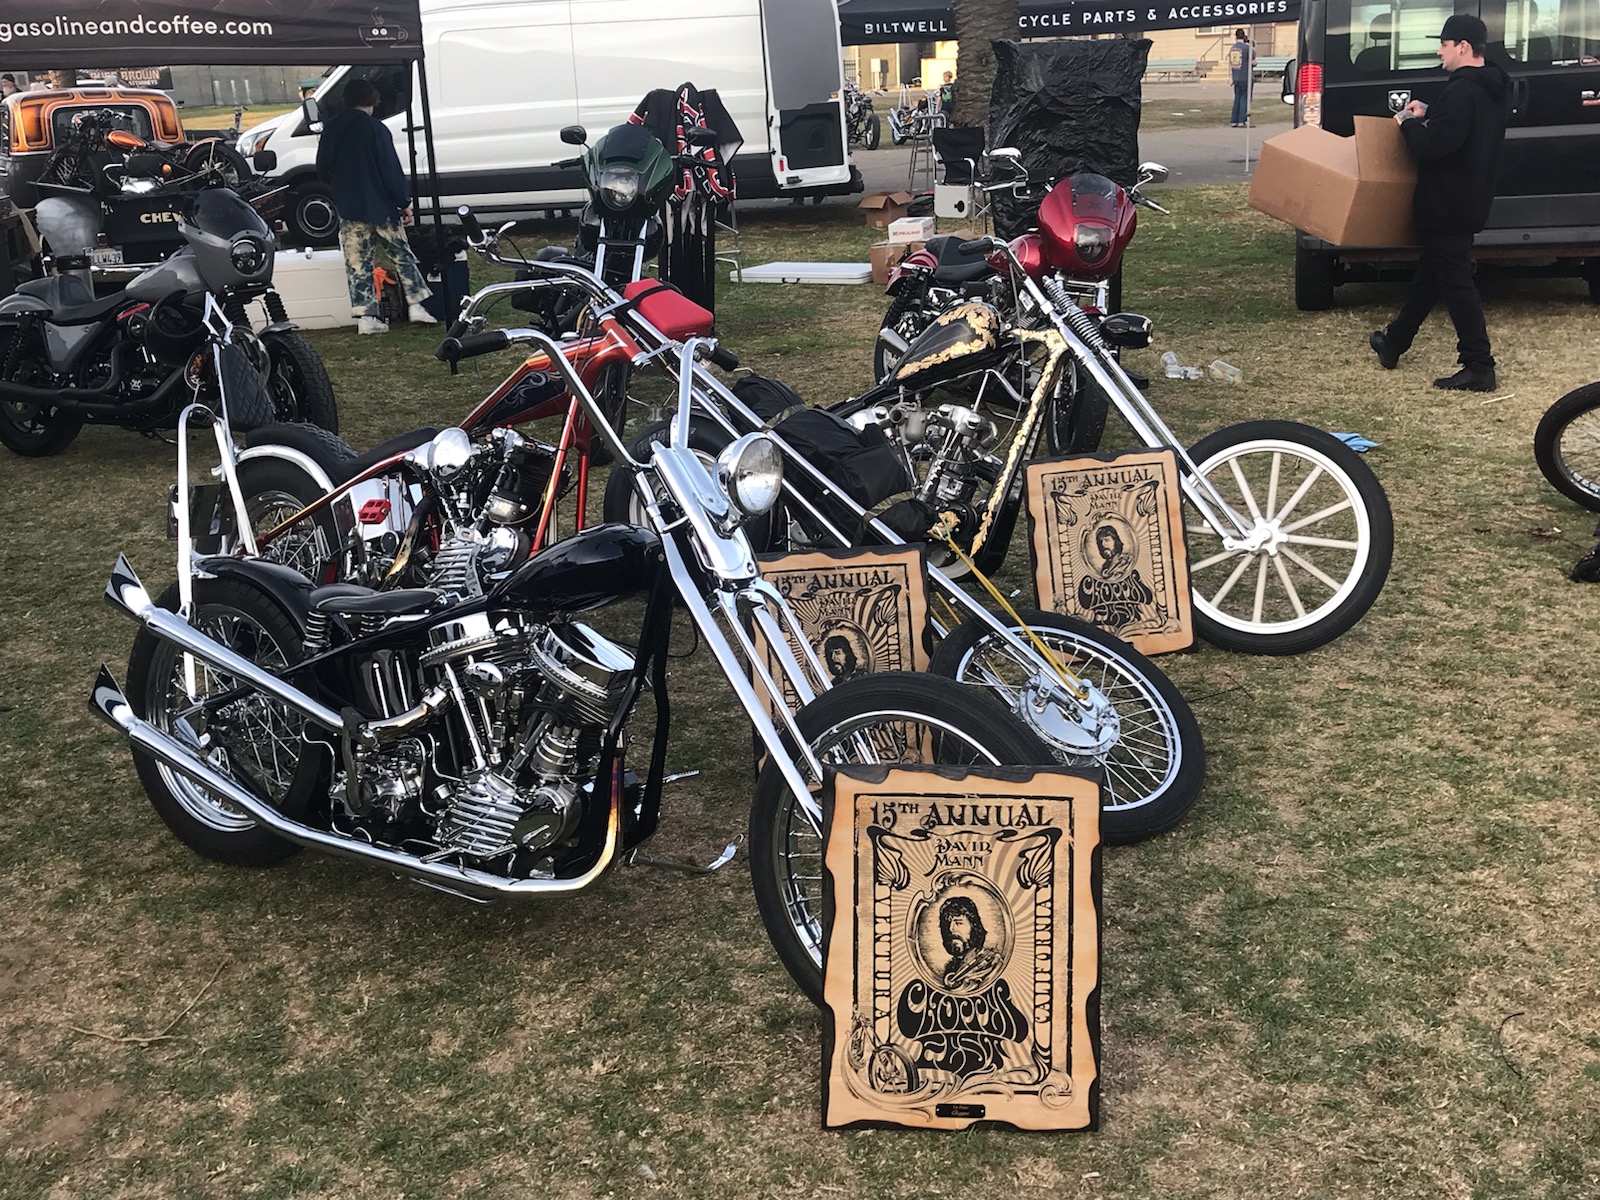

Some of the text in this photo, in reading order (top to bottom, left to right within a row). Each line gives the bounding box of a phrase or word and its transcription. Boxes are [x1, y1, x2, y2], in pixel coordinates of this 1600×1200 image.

[0, 14, 273, 42] gasolineandcoffee.com
[864, 1, 1288, 35] BILTWELL CYCLE PARTS & ACCESSORIES
[119, 69, 160, 81] BROWN
[1080, 468, 1154, 490] ANNUAL
[807, 569, 896, 592] ANNUAL
[920, 801, 1054, 830] ANNUAL
[934, 837, 993, 855] DAVID
[926, 855, 984, 875] MANN
[874, 896, 892, 1021] VENTURA
[1034, 897, 1052, 1024] CALIFORNIA
